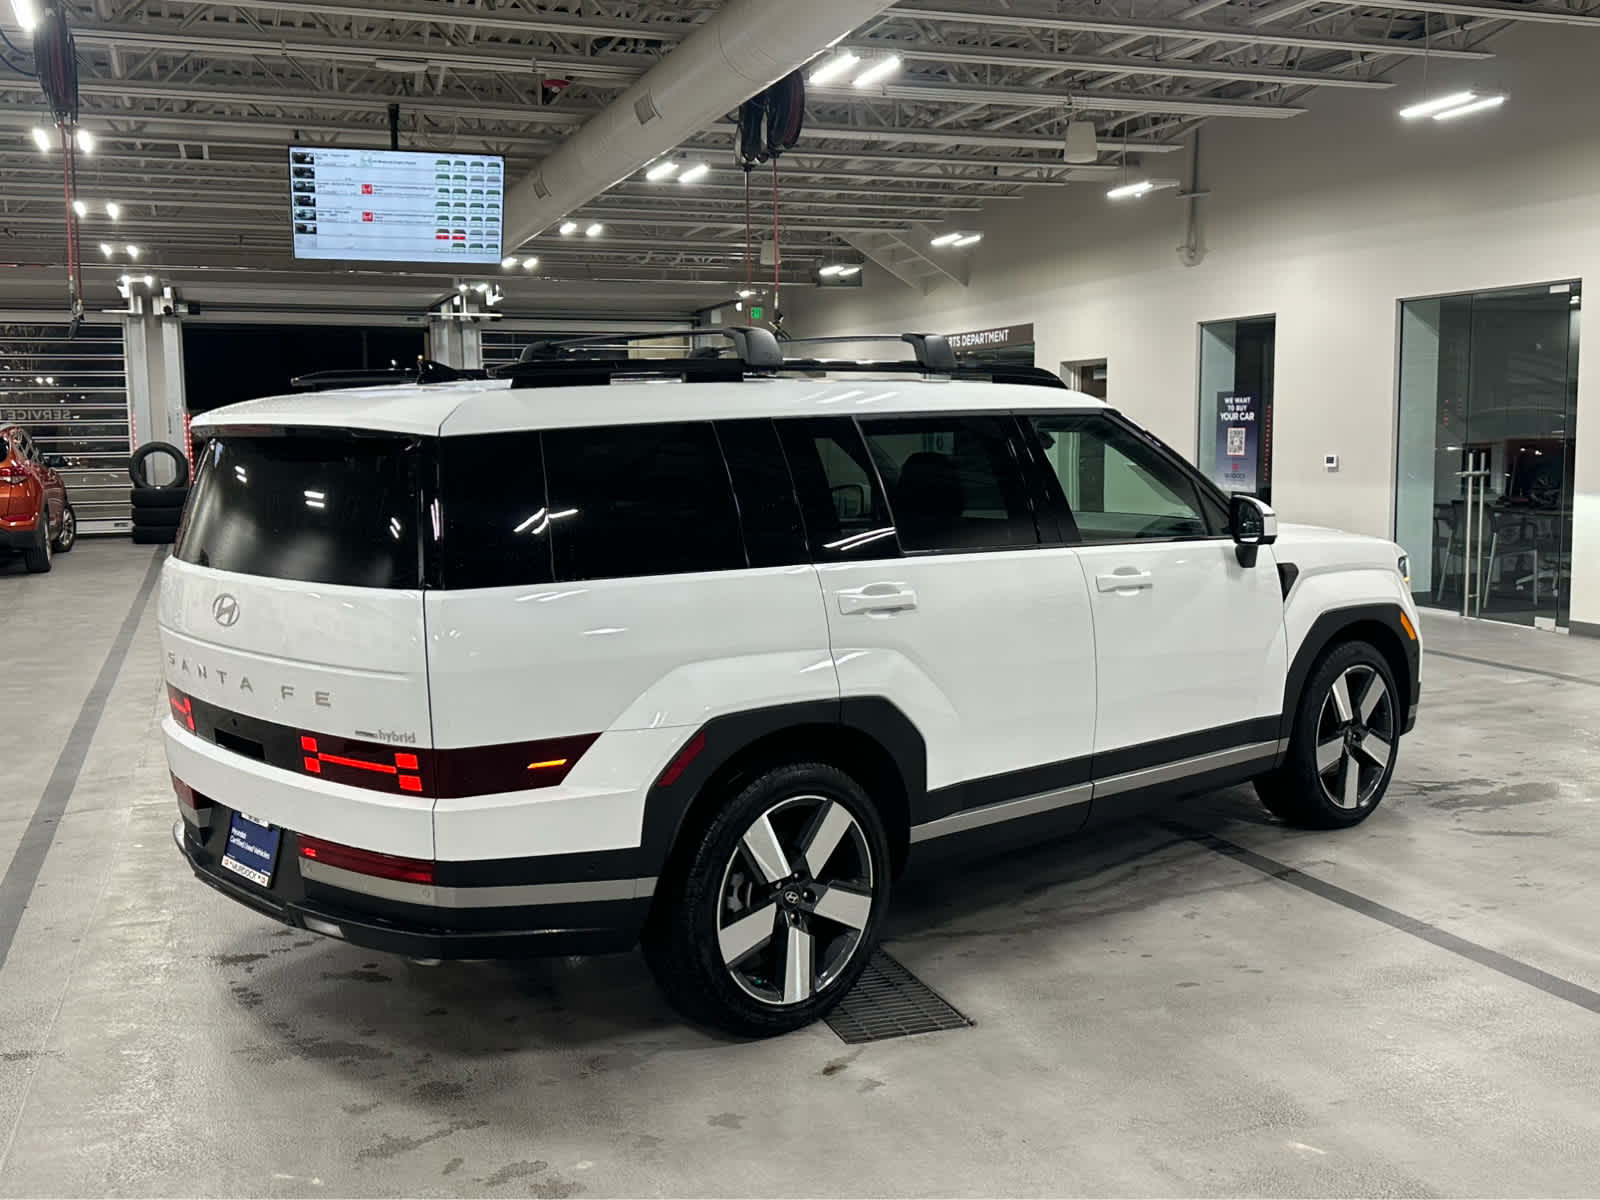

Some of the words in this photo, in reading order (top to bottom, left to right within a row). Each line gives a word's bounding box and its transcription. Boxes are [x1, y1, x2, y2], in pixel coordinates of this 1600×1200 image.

[961, 329, 1009, 346] DEPARTMENT
[1220, 412, 1238, 421] YOUR
[1239, 412, 1255, 421] CAR
[168, 652, 254, 693] SANTA
[281, 685, 332, 708] FE
[378, 729, 416, 744] hybrid
